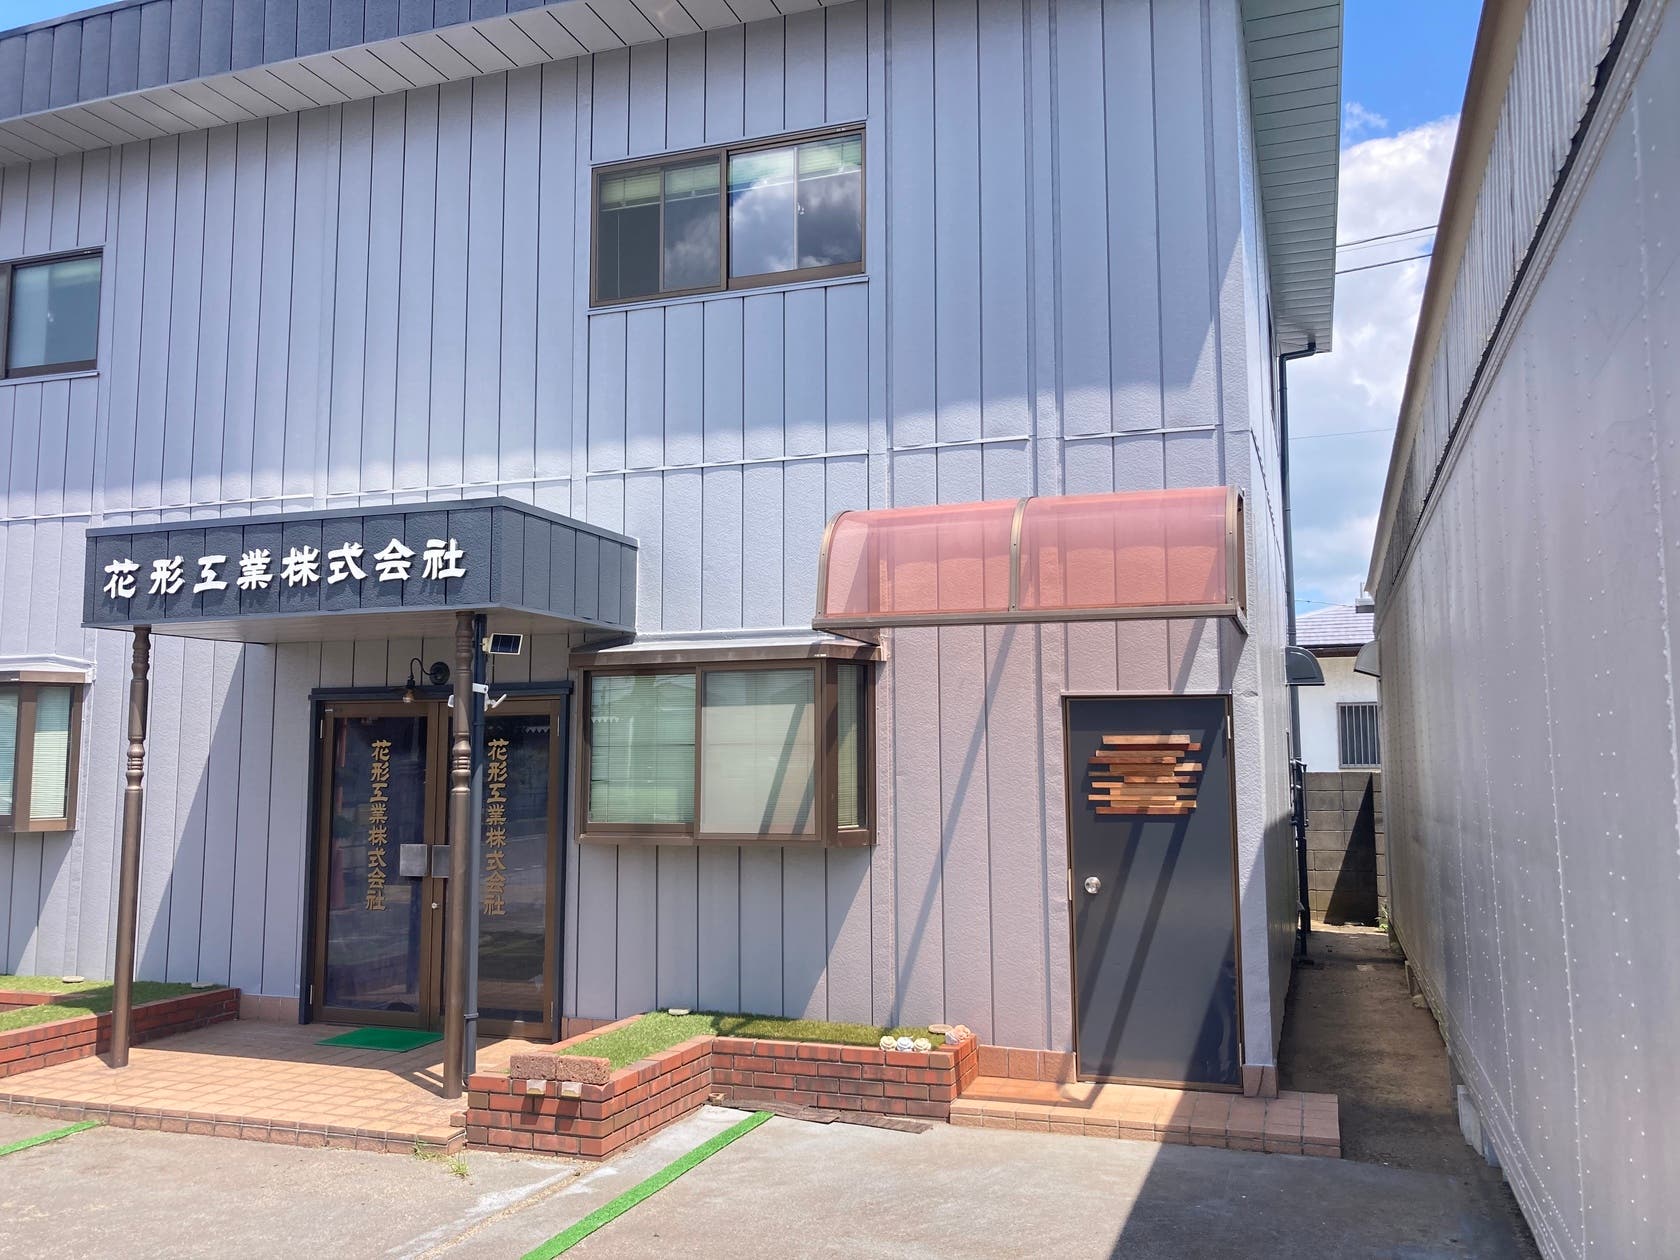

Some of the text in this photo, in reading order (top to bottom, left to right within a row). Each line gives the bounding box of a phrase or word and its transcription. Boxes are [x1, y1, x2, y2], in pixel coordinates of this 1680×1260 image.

[103, 538, 467, 599] 花形工業株式会社
[365, 739, 391, 911] 花形工業株式会社
[483, 738, 509, 914] 花形工業株式会社
